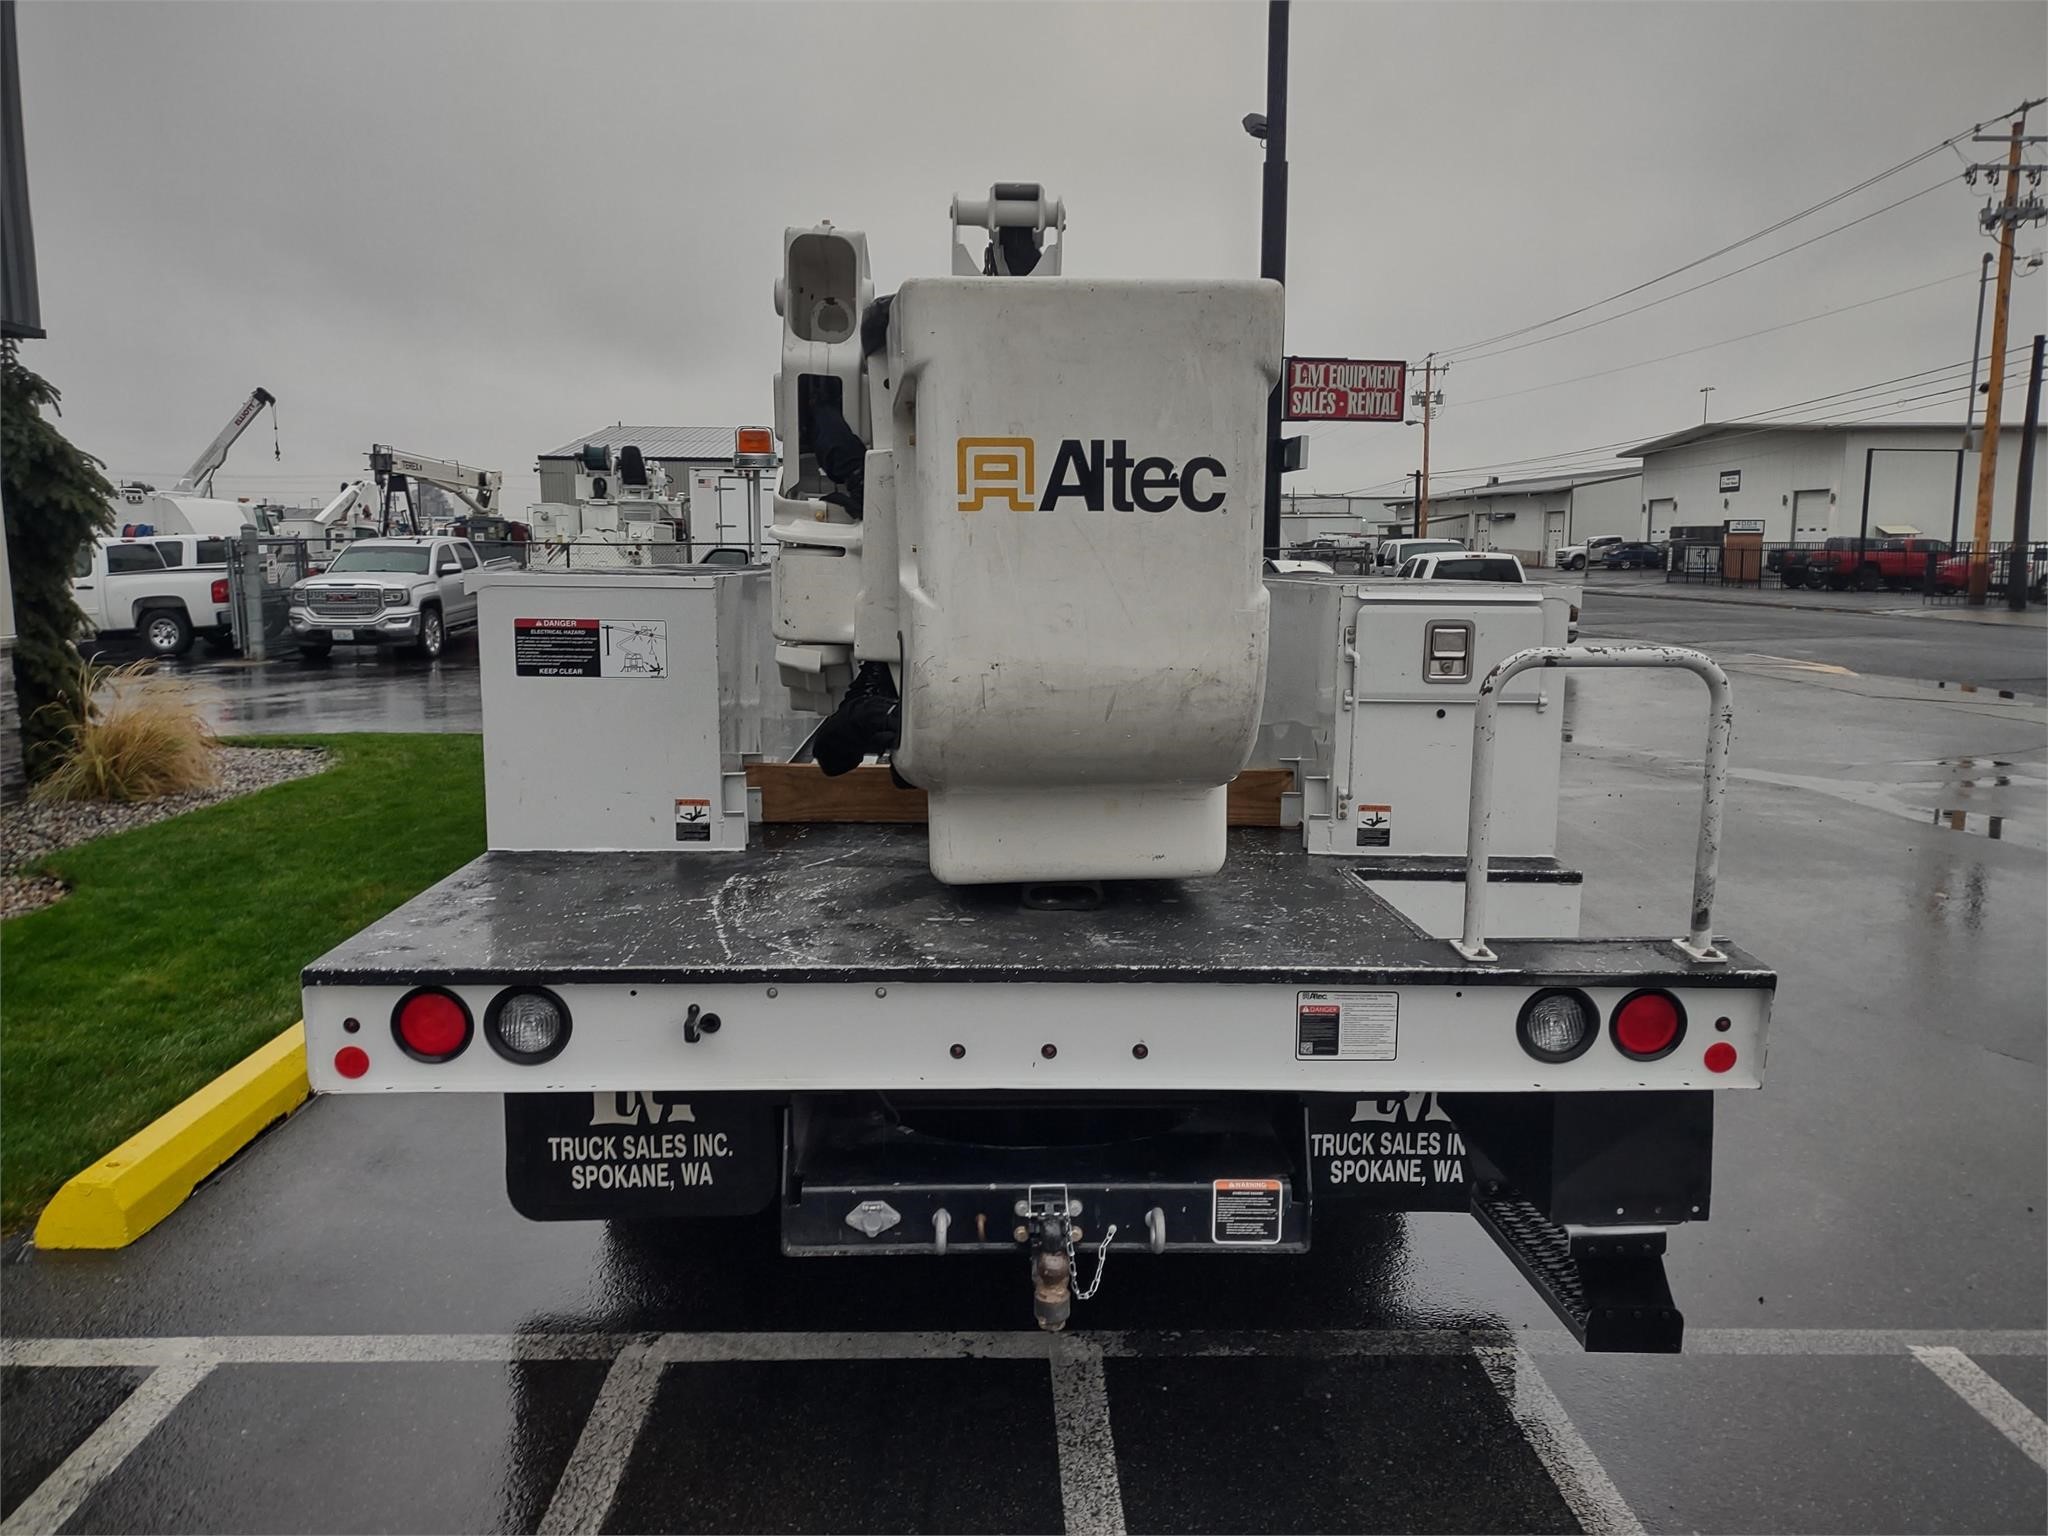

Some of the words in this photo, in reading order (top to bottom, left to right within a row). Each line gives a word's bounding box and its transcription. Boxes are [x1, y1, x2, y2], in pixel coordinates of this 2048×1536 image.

[1329, 364, 1400, 390] EQUIPMENT
[234, 402, 255, 426] ELLIOTT
[1292, 391, 1336, 414] SALES
[1348, 391, 1398, 415] RENTAL
[1039, 439, 1227, 513] Altec
[548, 1136, 617, 1161] TRUCK
[623, 1134, 687, 1160] SALES
[693, 1132, 733, 1158] INC.
[1311, 1132, 1375, 1157] TRUCK
[1380, 1132, 1441, 1155] SALES
[1447, 1133, 1466, 1156] IN
[571, 1162, 675, 1191] SPOKANE,
[681, 1162, 714, 1186] WA
[1330, 1159, 1426, 1186] SPOKANE,
[1433, 1160, 1464, 1183] WA
